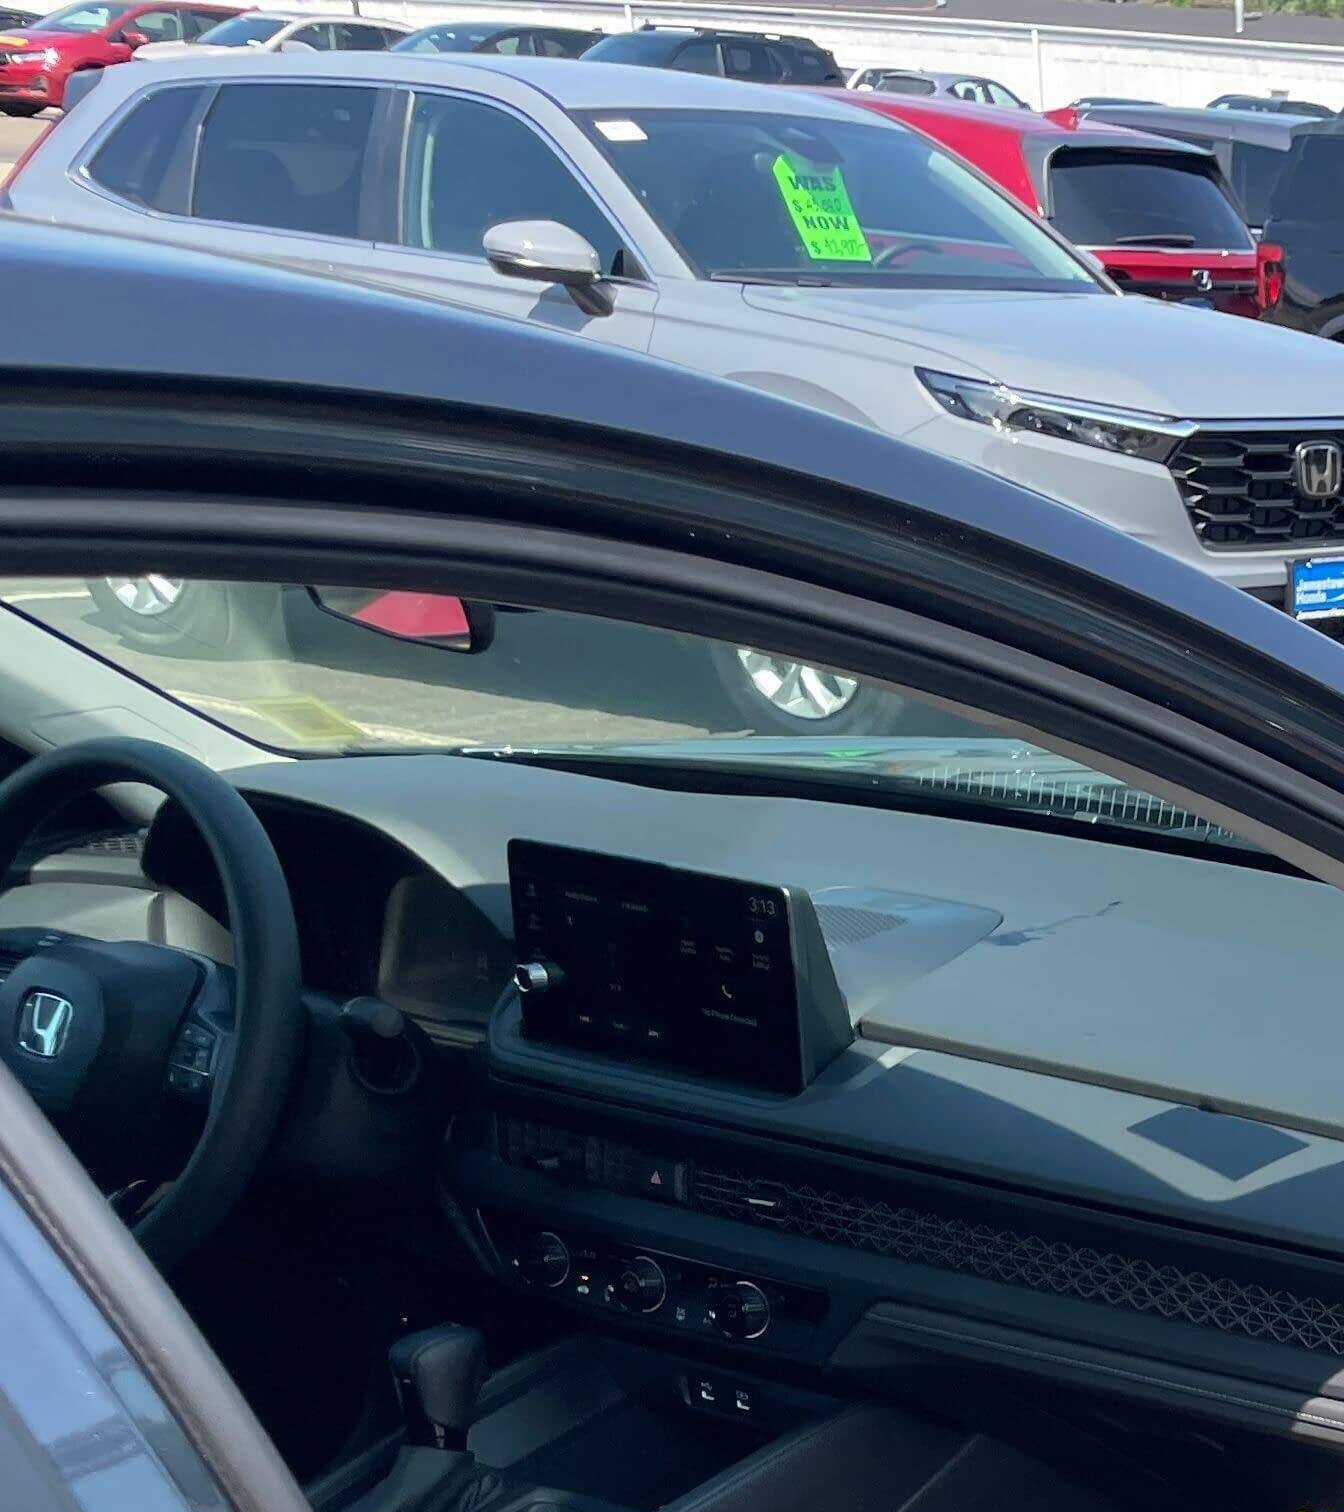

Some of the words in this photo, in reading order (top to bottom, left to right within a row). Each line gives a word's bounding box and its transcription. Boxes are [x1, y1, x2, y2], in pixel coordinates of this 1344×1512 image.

[787, 175, 836, 191] WAS
[802, 215, 849, 230] NOW
[748, 896, 776, 915] 3:13
